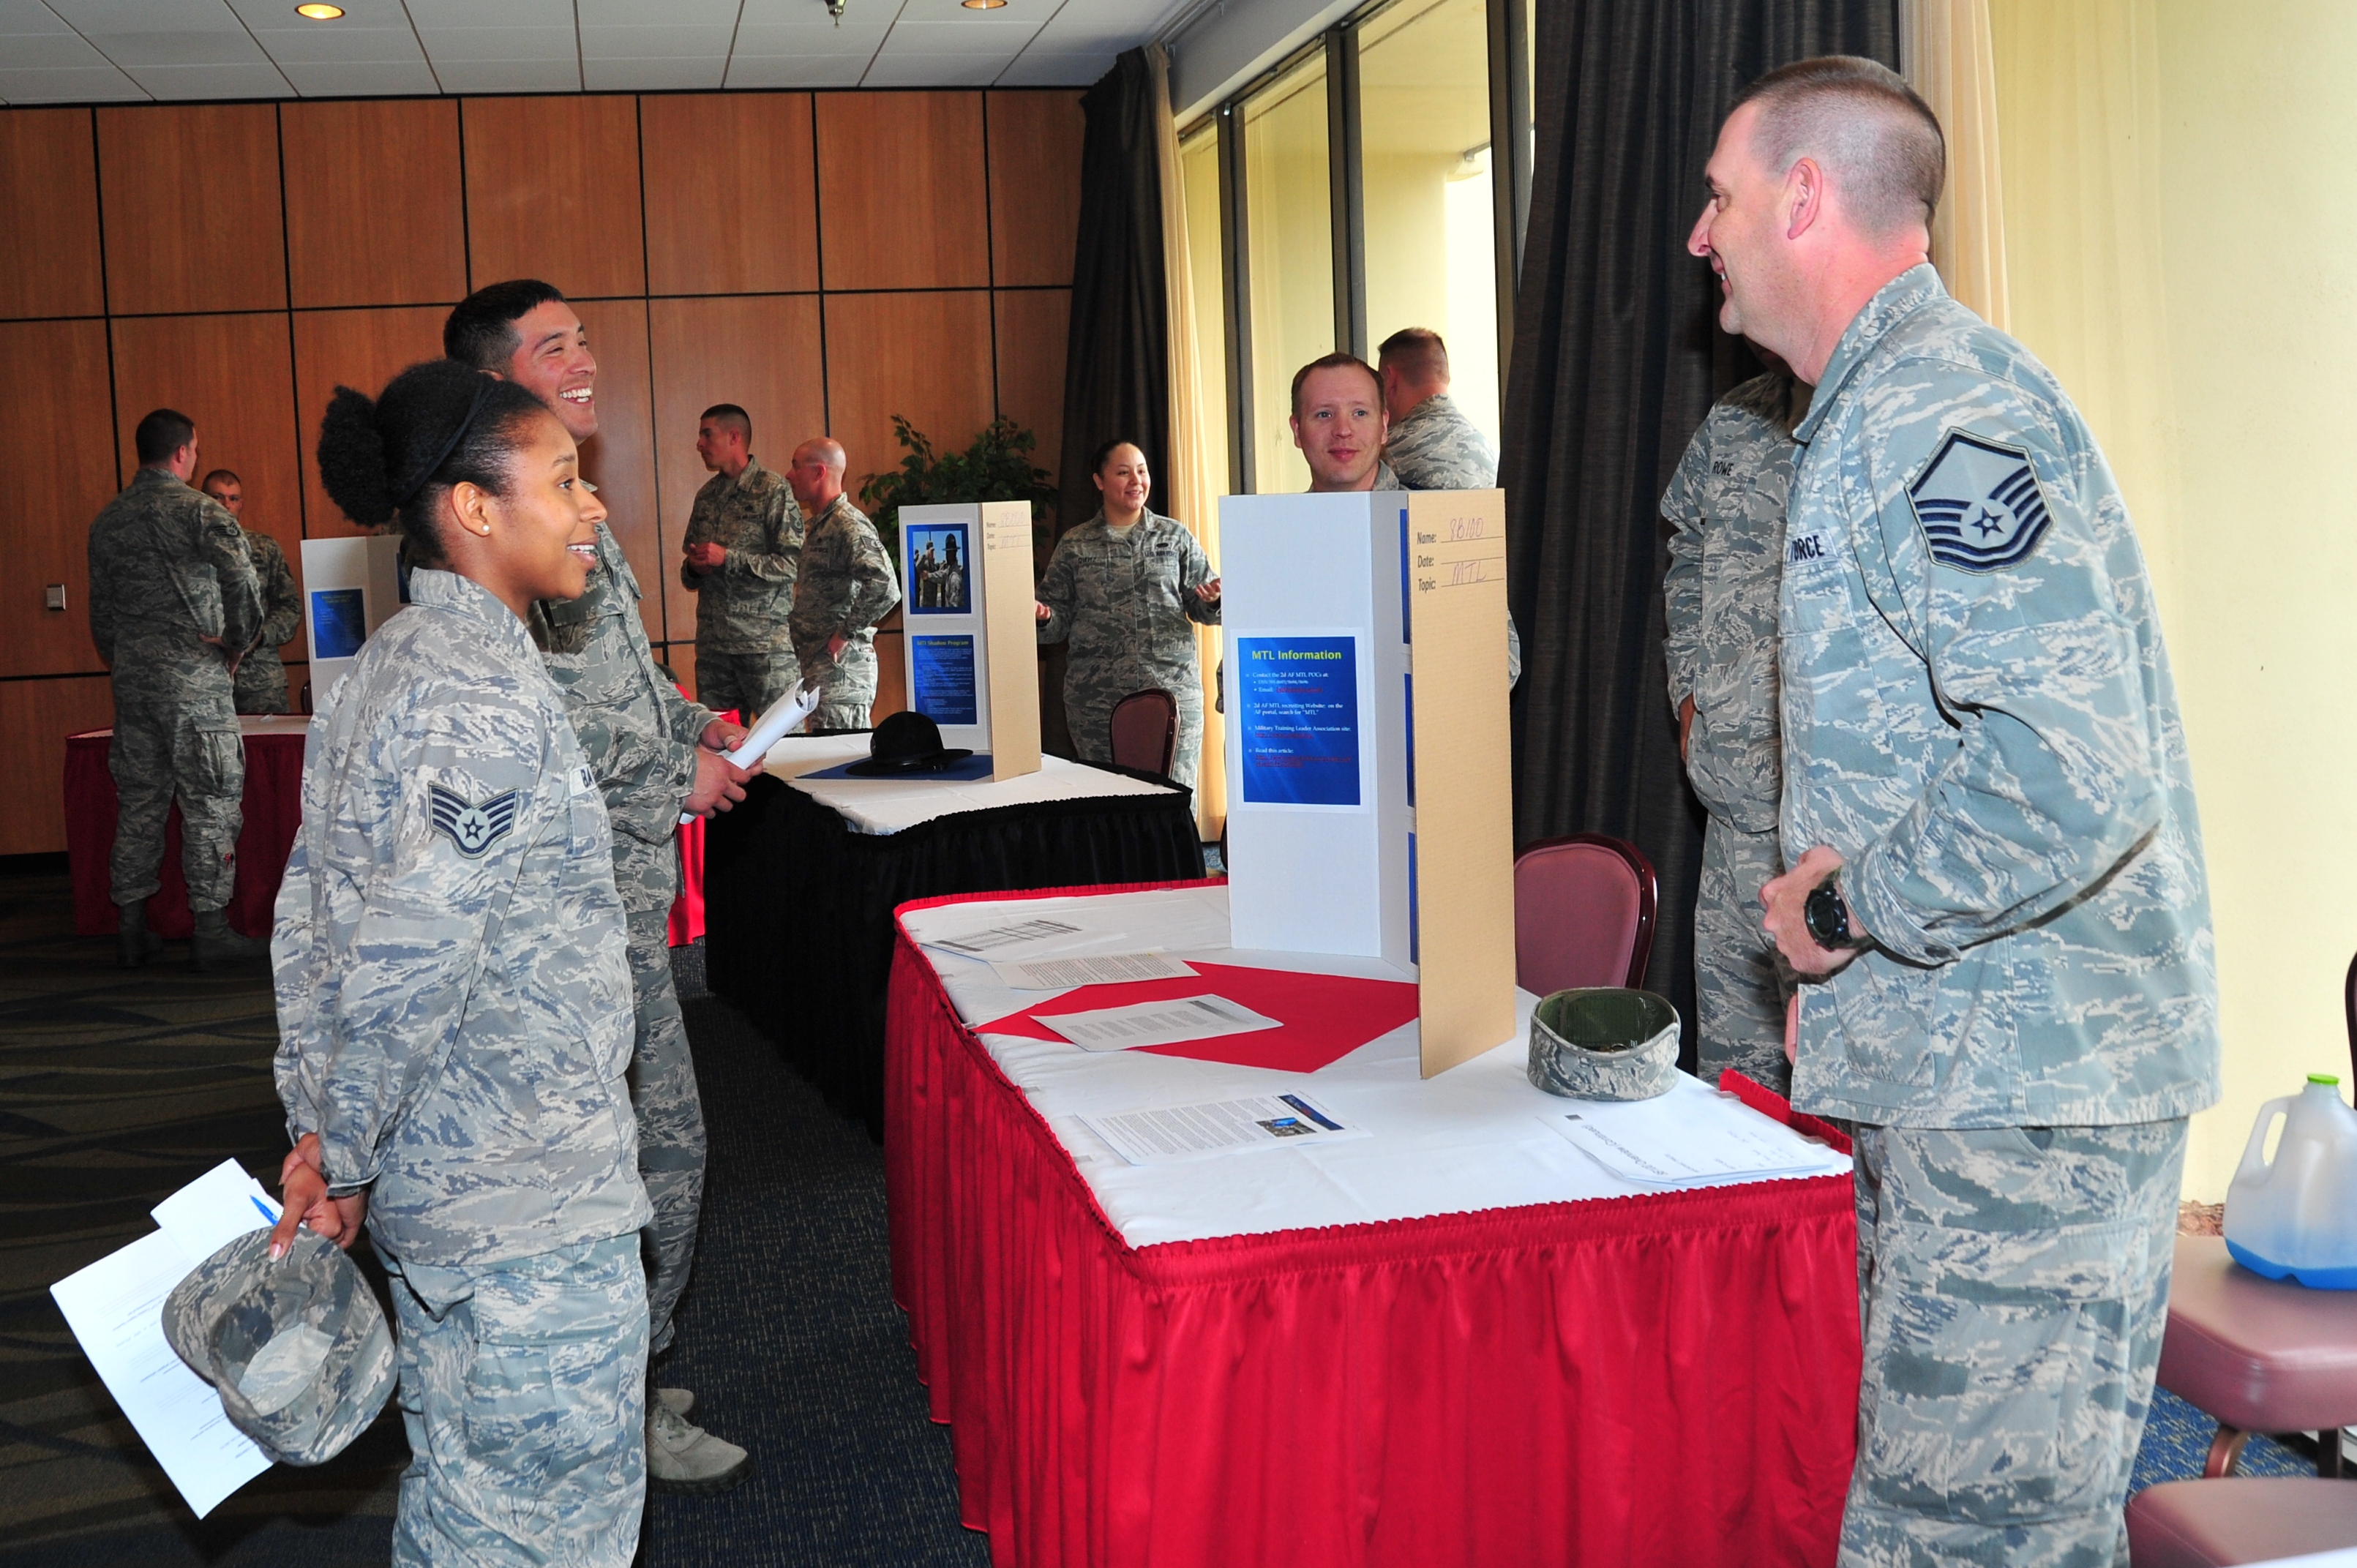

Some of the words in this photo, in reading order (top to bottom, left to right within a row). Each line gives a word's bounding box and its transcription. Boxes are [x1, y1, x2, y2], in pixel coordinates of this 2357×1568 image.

[1712, 461, 1734, 476] ROWE
[1417, 532, 1436, 544] Name:
[1417, 555, 1434, 568] Date:
[1452, 560, 1486, 585] MTL
[1418, 577, 1436, 594] Topic:
[1252, 650, 1275, 660] MTL
[1278, 650, 1342, 660] Information
